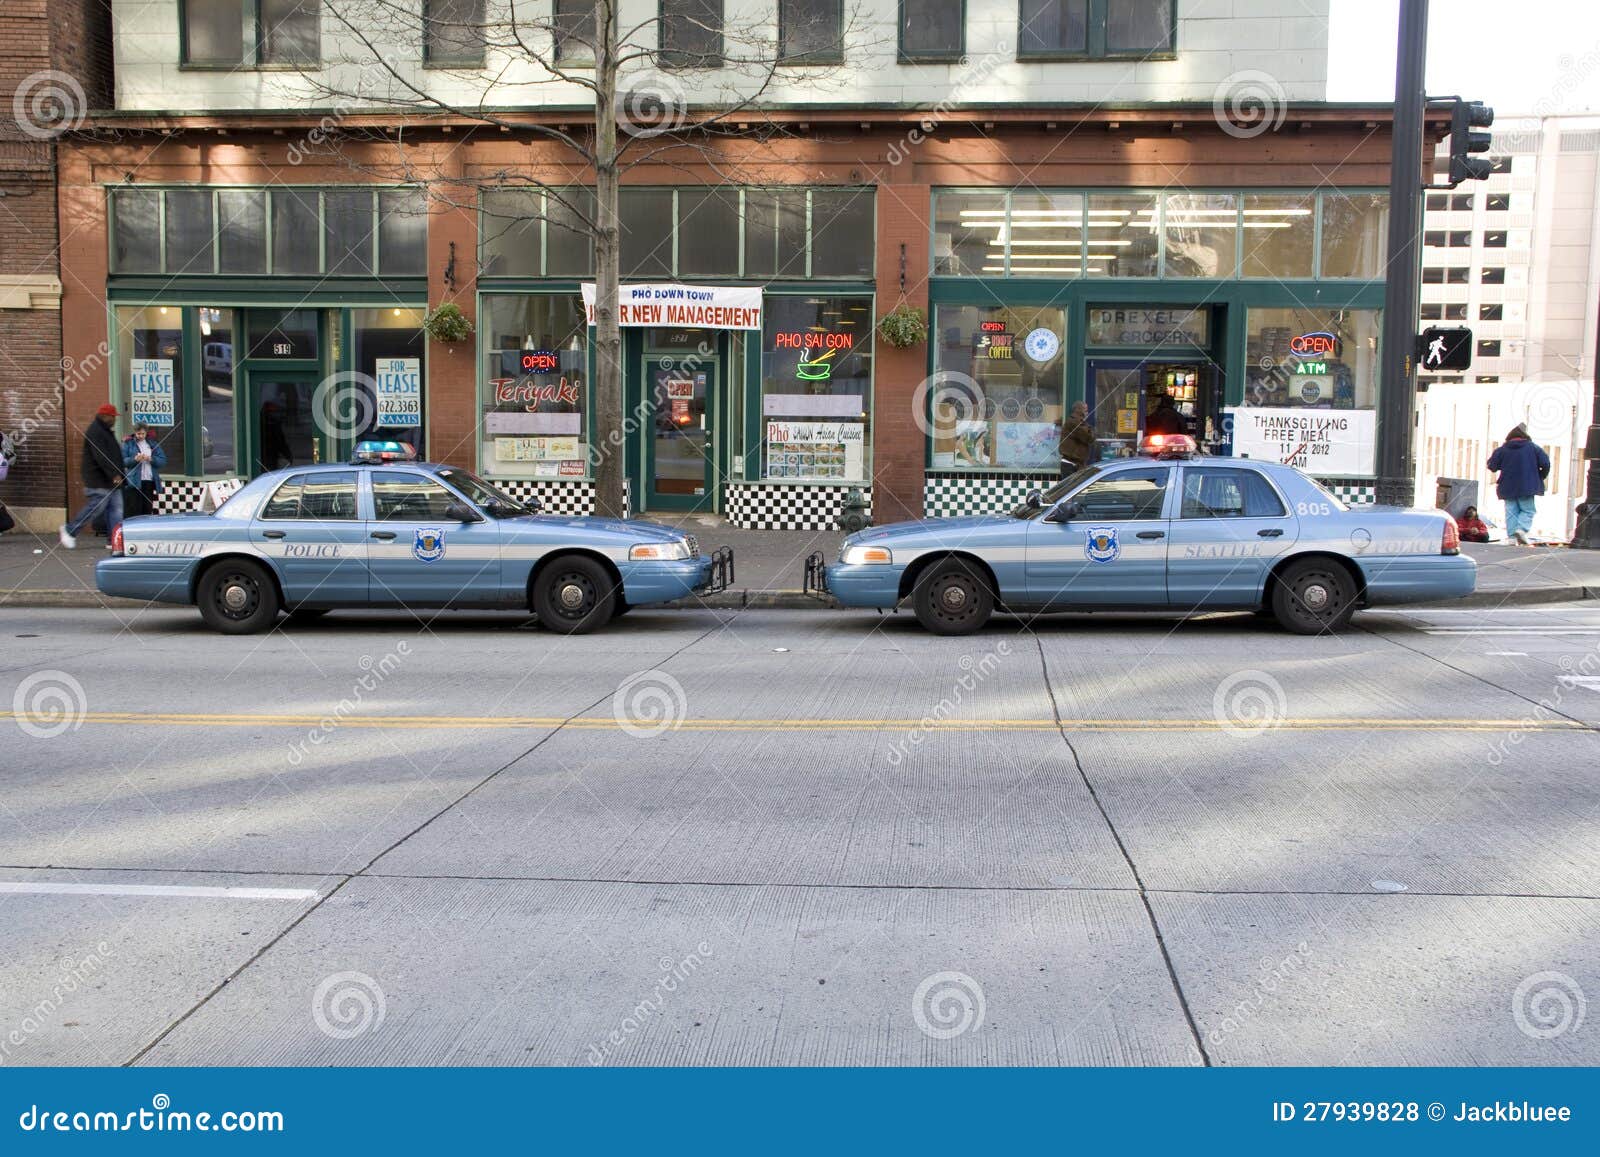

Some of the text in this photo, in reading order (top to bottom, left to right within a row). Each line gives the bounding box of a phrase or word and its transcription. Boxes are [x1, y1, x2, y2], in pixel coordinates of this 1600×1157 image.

[655, 290, 684, 299] DOWN
[686, 290, 714, 301] TOWN
[632, 304, 662, 323] NEW
[667, 305, 759, 327] MANAGEMENT
[1101, 311, 1179, 324] DREXEL
[981, 322, 1005, 331] OPEN
[776, 333, 801, 348] PHO
[1290, 336, 1335, 352] OPEN
[273, 344, 291, 354] 519
[144, 360, 159, 373] FOR
[390, 360, 405, 373] FOR
[523, 355, 556, 368] OPEN
[1297, 362, 1326, 374] ATM
[132, 373, 171, 393] LEASE
[378, 373, 418, 393] LEASE
[488, 377, 580, 412] Teriyaki
[134, 400, 172, 413] 622.3363
[379, 400, 418, 413] 622.3363
[380, 414, 418, 425] SAMIS
[1254, 415, 1348, 430] THANKSGIVING
[1264, 429, 1331, 443] FREE MEAL
[1280, 443, 1330, 455] 11 22 2012
[1291, 456, 1307, 468] AM
[1297, 502, 1330, 517] 805
[146, 543, 209, 556] SEATTLE
[284, 543, 343, 558] POLICE
[1183, 543, 1262, 559] SEATTLE
